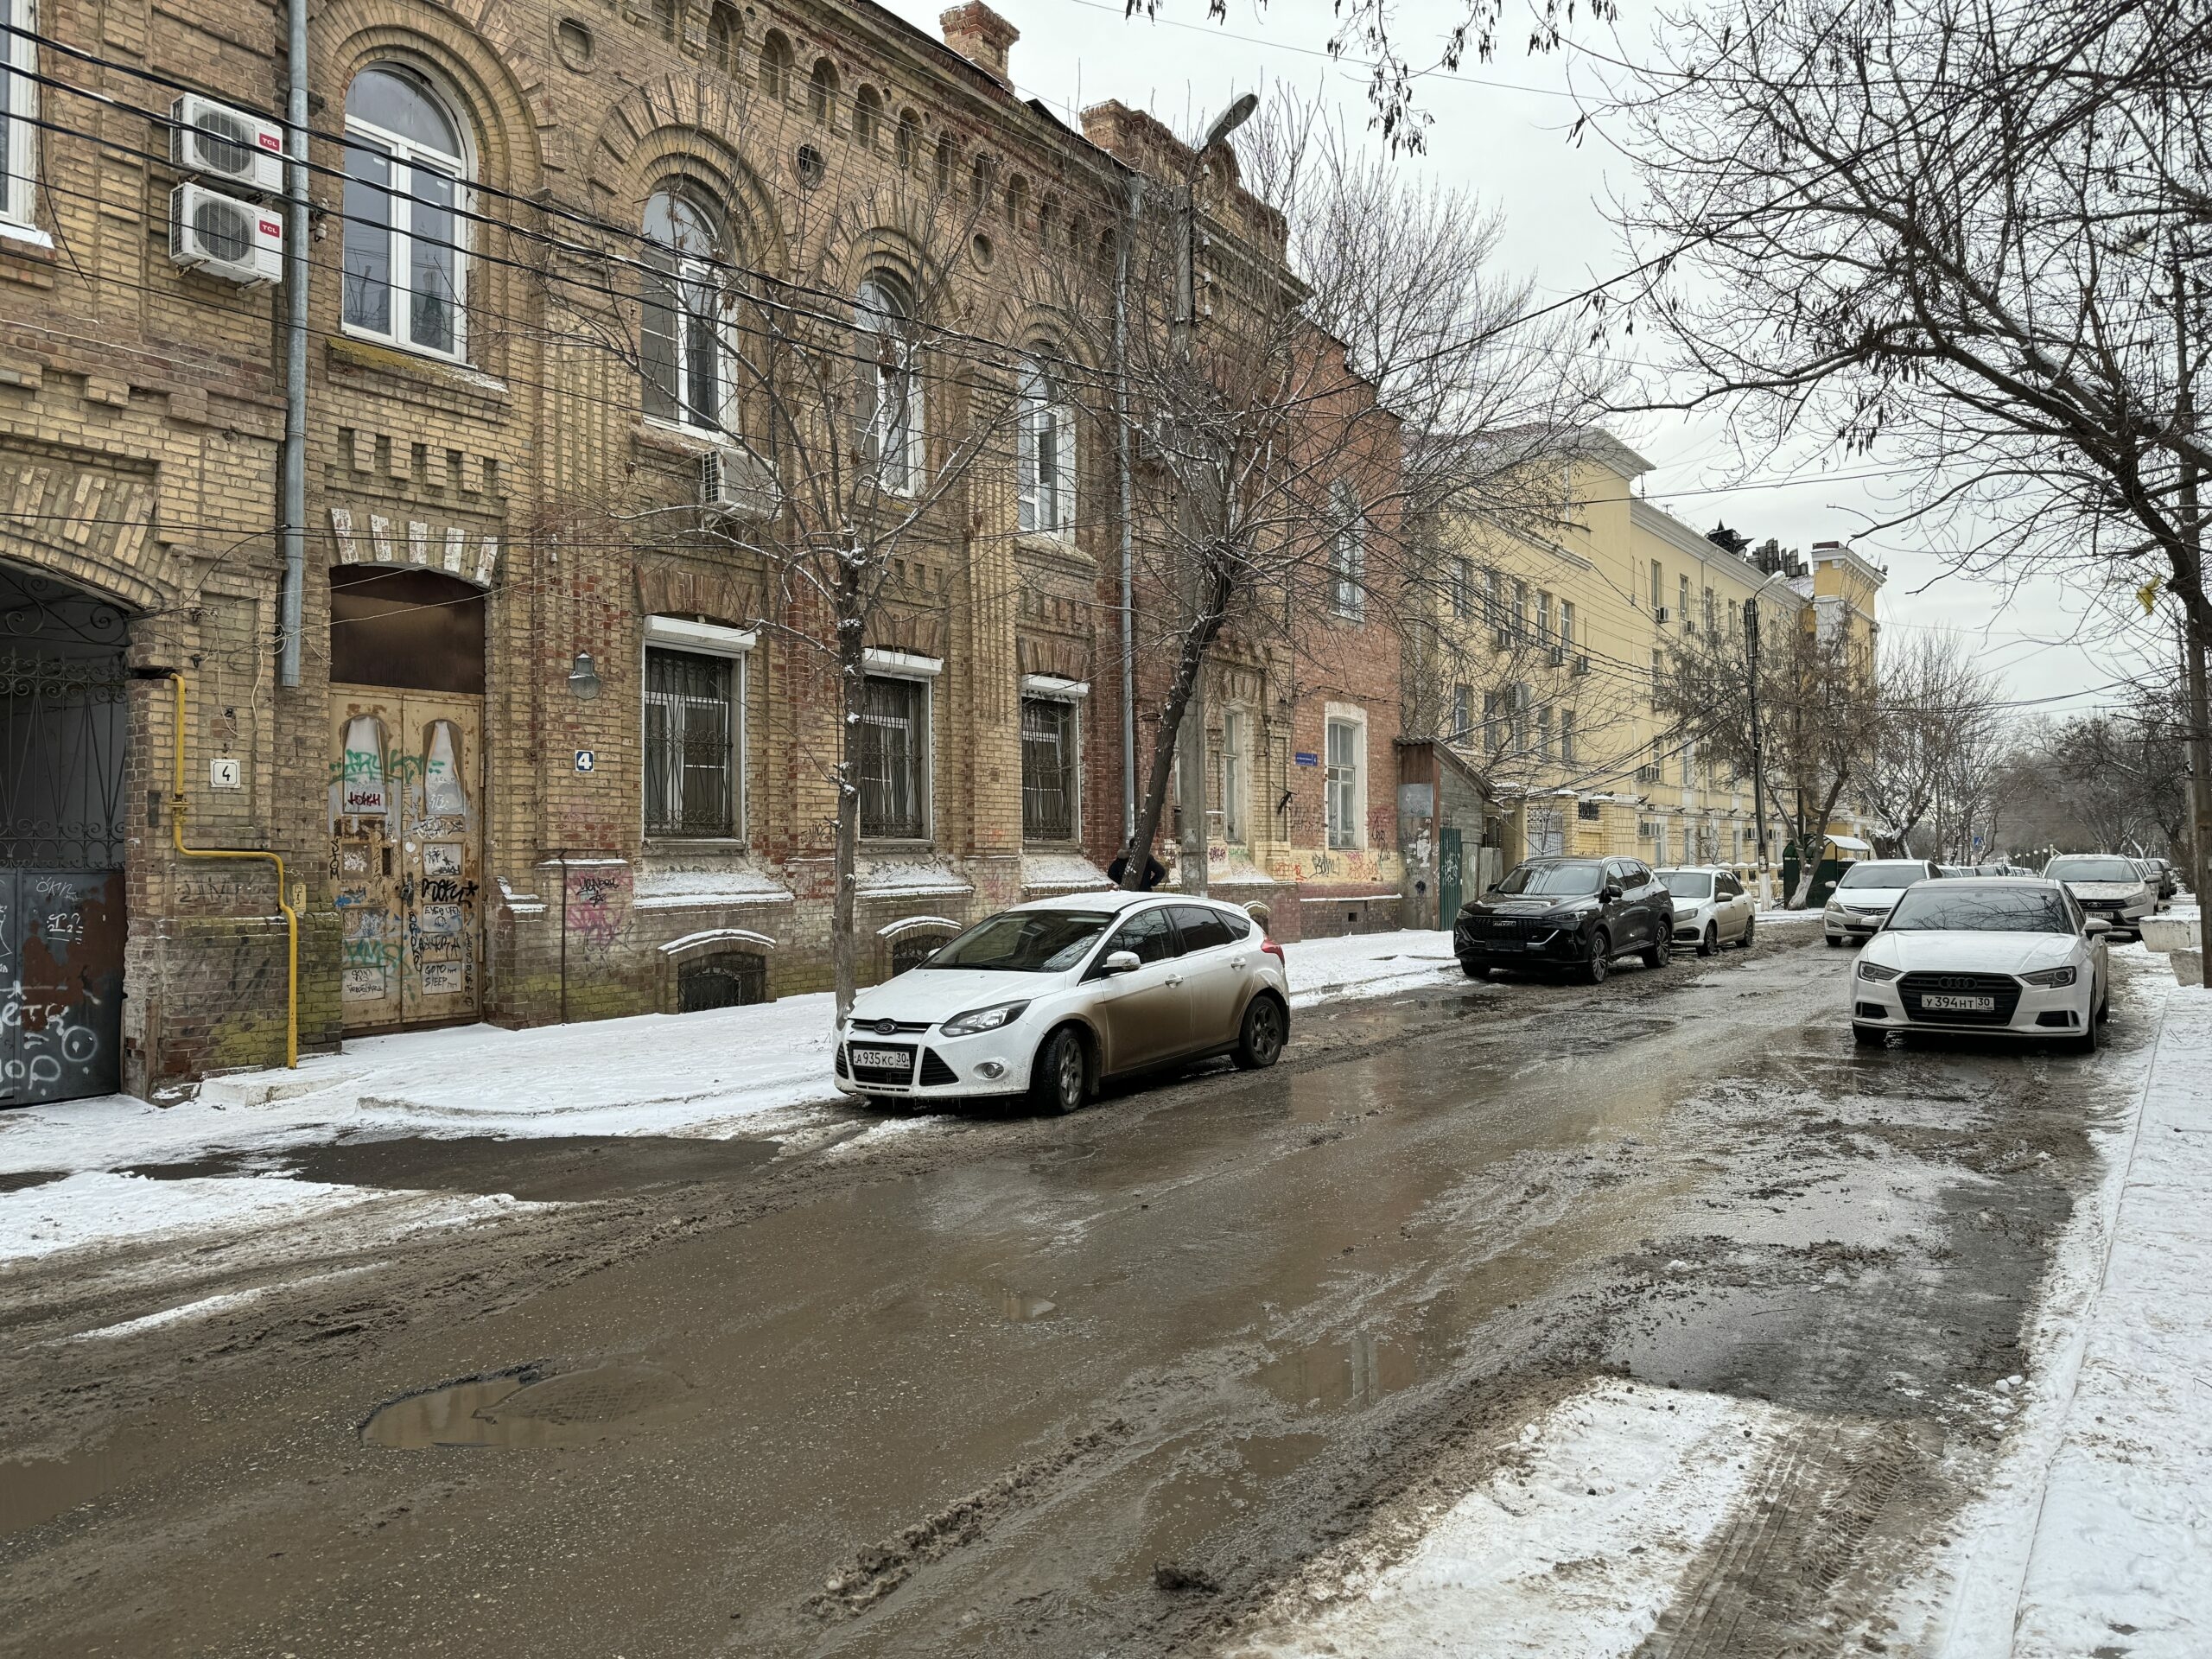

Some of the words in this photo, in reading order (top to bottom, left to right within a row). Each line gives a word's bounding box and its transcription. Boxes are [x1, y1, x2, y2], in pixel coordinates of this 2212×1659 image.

[262, 137, 277, 148] TCL
[262, 224, 277, 234] TCL
[578, 753, 592, 770] 4
[221, 765, 231, 782] 4
[1977, 997, 1991, 1007] 30
[896, 1052, 906, 1064] 30
